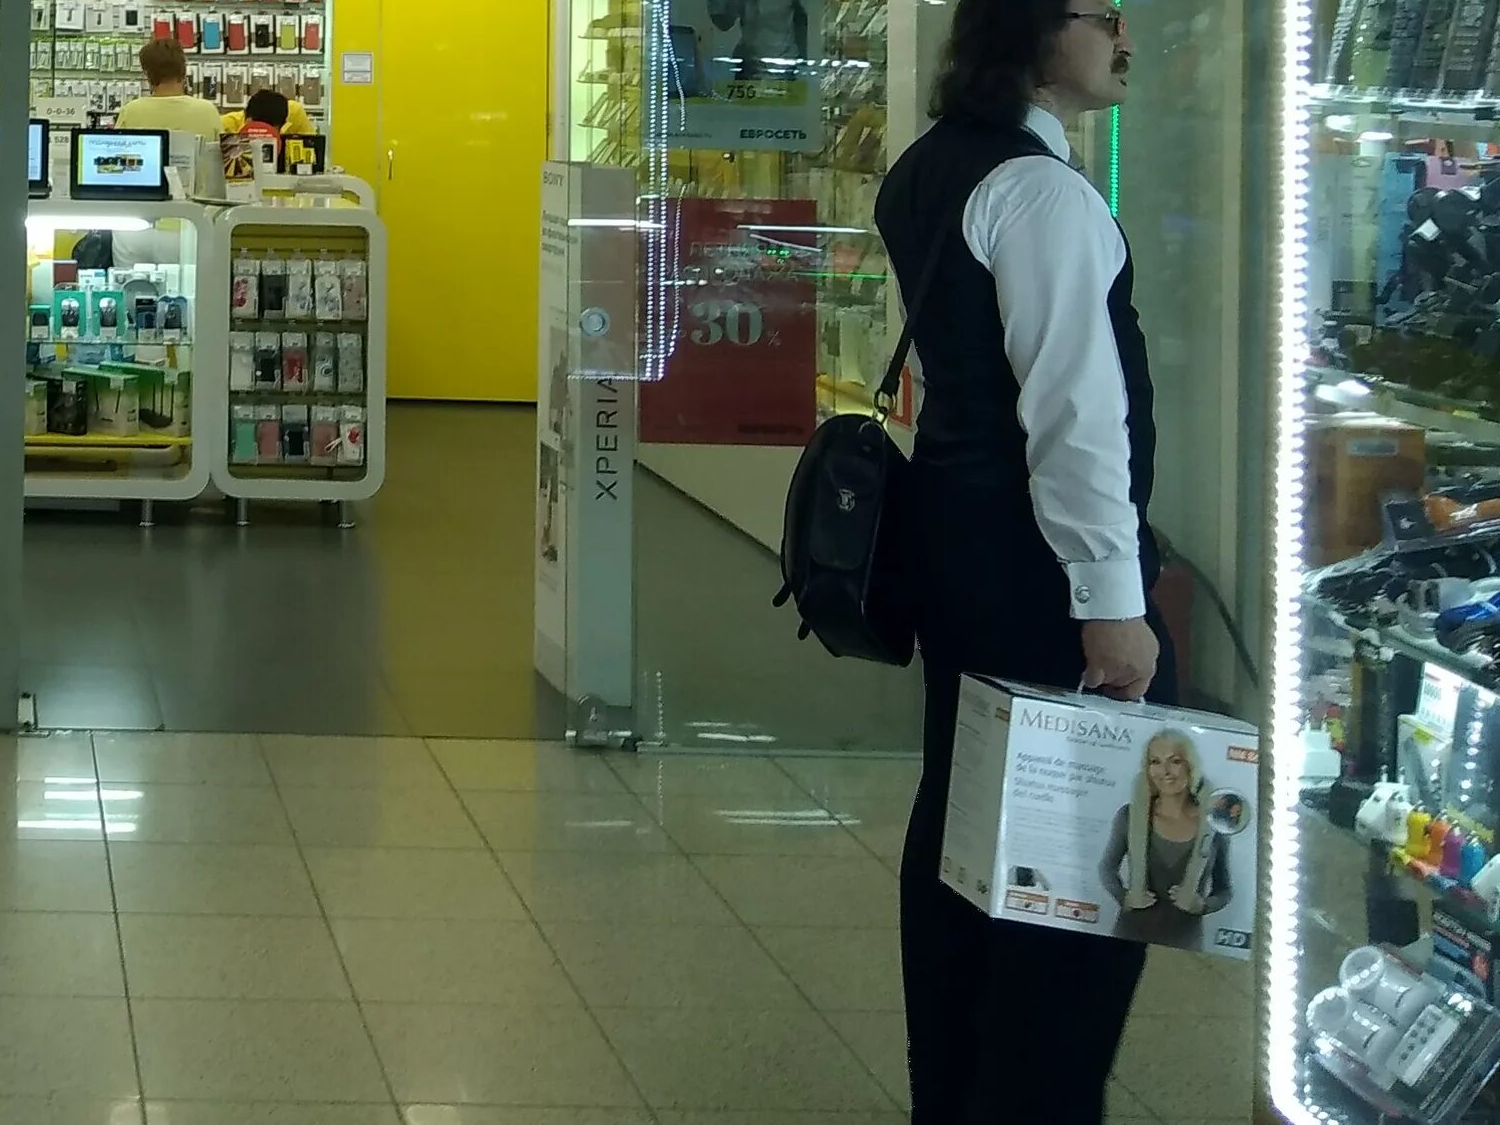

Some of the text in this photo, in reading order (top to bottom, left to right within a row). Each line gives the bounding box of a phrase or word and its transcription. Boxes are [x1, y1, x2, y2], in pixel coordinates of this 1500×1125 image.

[739, 129, 808, 140] ЕВРОСЕТЬ
[594, 376, 619, 502] XPERIA
[1019, 707, 1133, 744] MEDISANA
